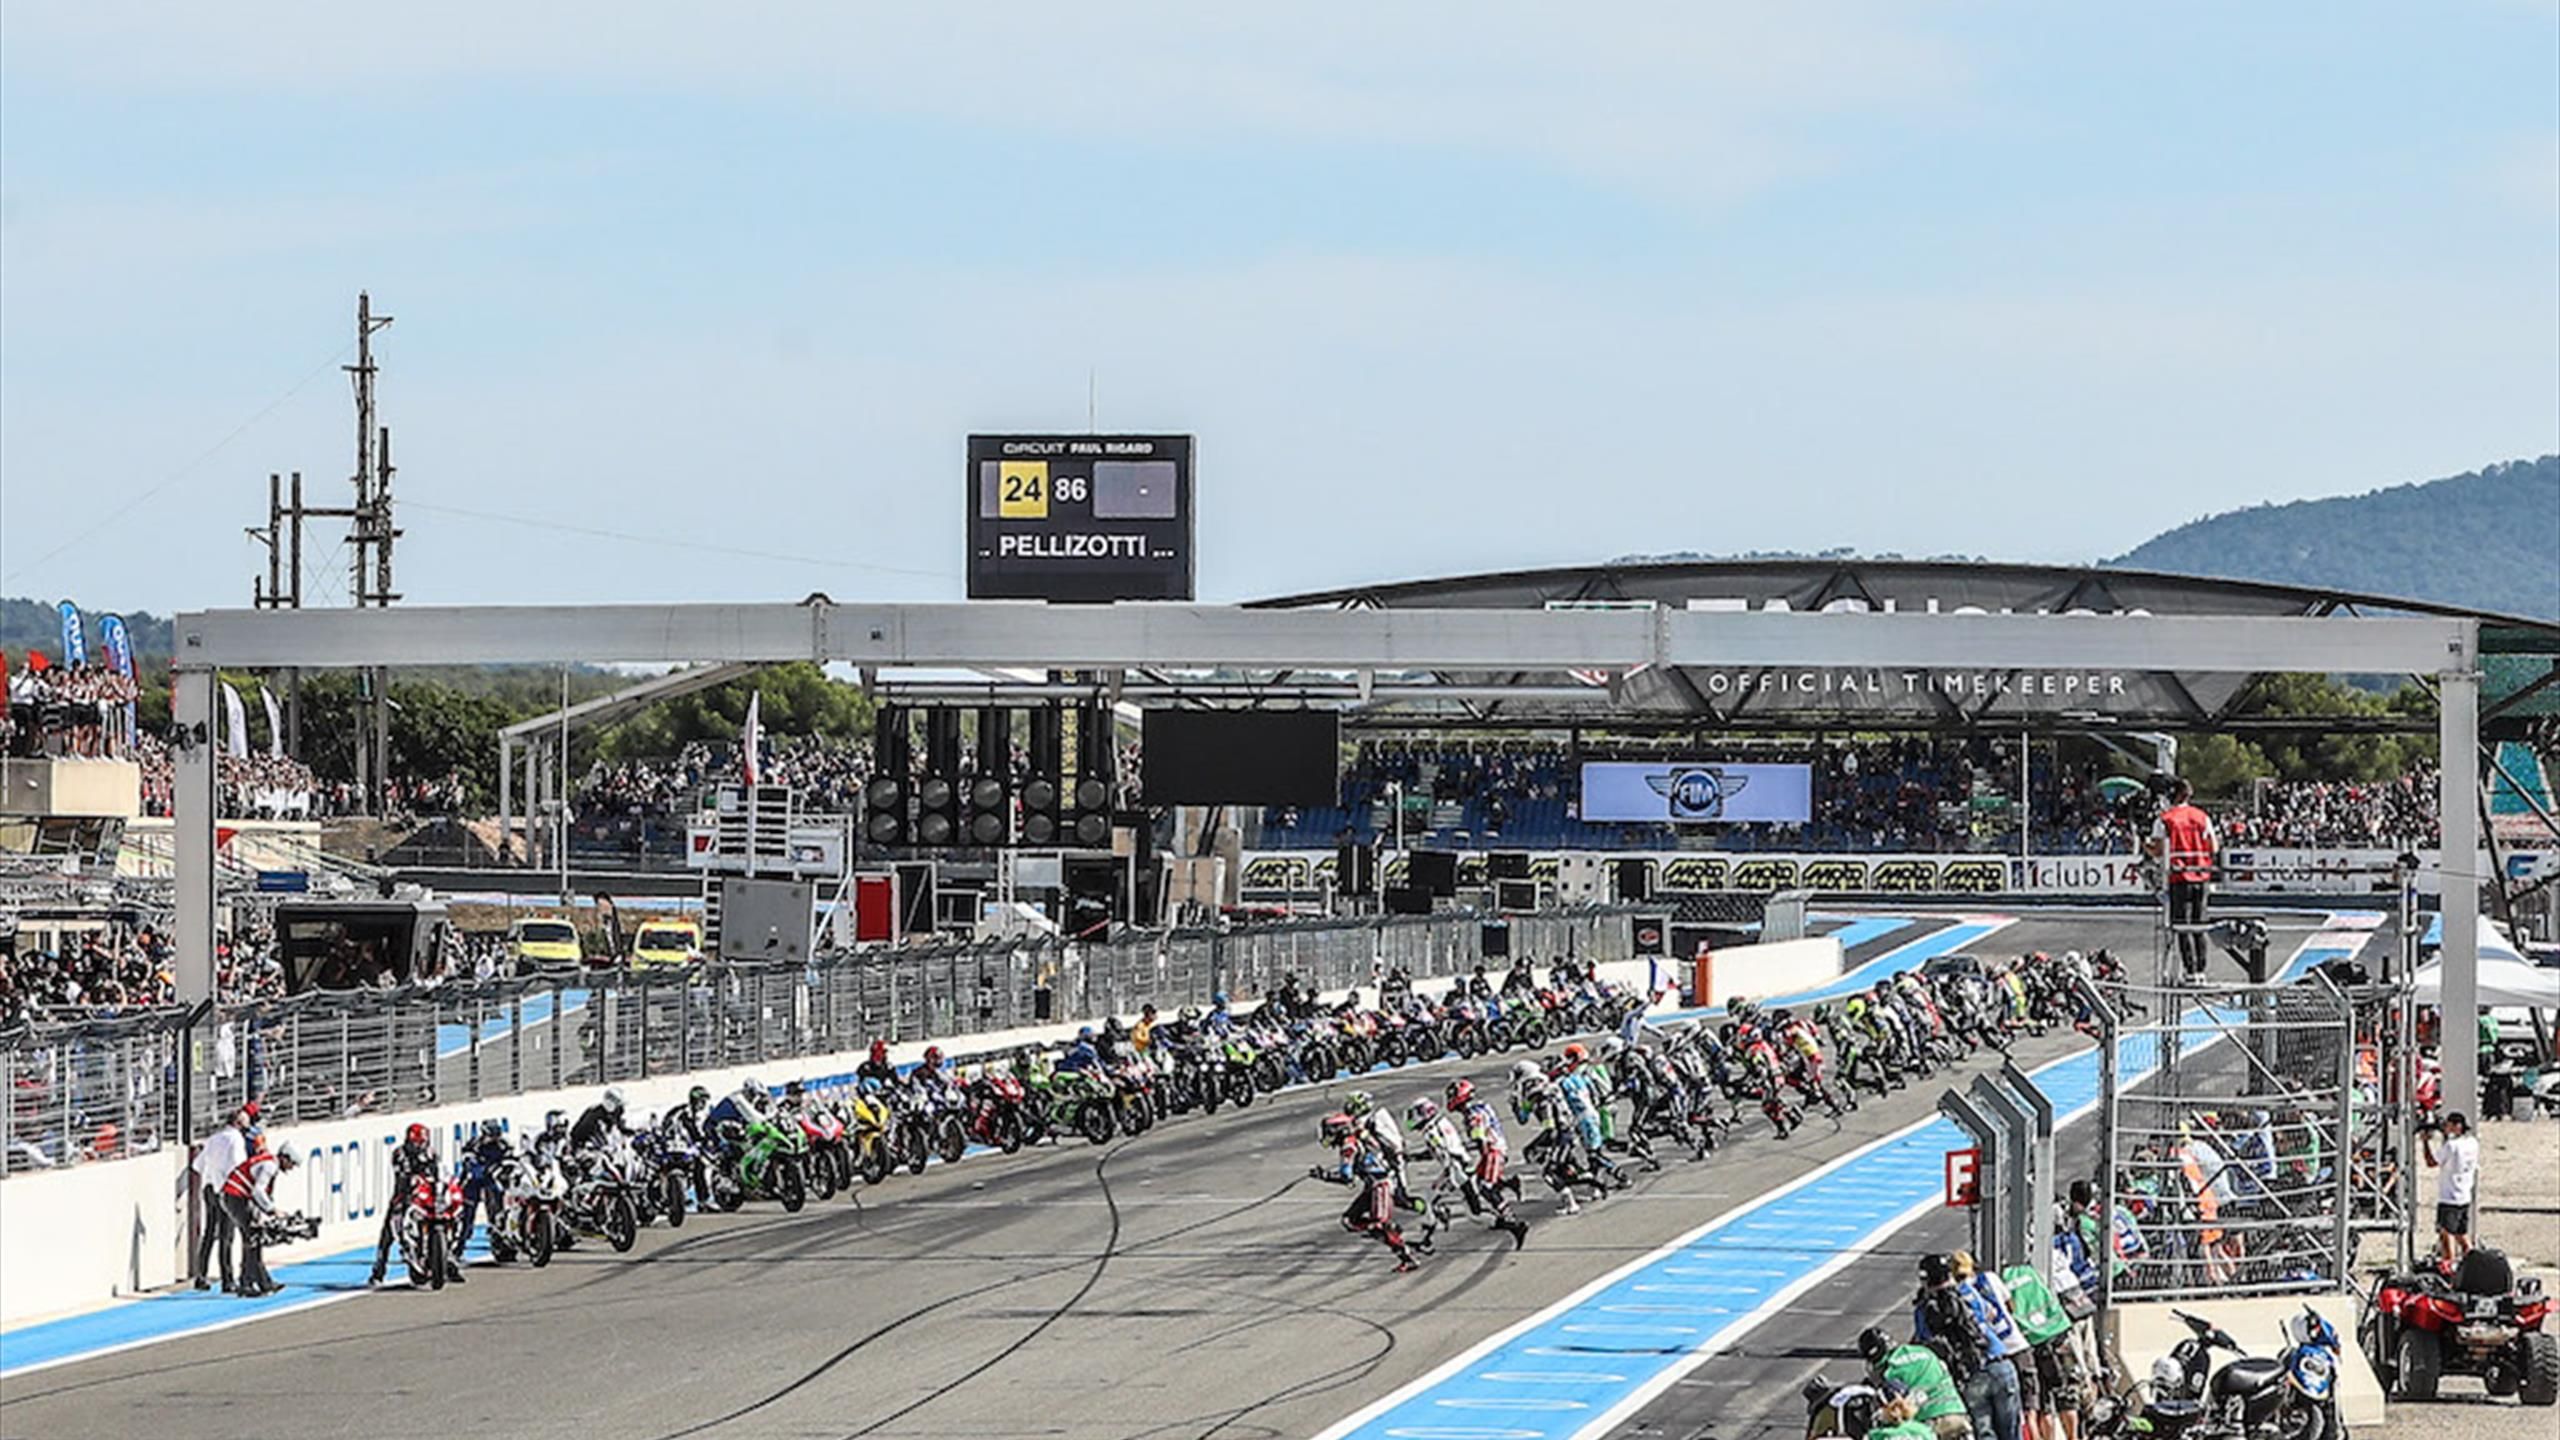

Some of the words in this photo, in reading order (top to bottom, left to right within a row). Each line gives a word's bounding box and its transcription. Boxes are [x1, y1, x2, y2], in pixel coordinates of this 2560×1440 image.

[1003, 442, 1066, 454] CIRCUIT
[1069, 442, 1103, 454] PAUL
[1105, 442, 1154, 454] RICARD
[1004, 477, 1042, 502] 24
[1055, 478, 1087, 501] 86
[1000, 535, 1146, 556] PELLIZOTTI
[1708, 672, 1880, 693] OFFICIAL
[1903, 673, 2127, 694] TIMEKEEPER
[1680, 782, 1713, 804] FIM
[2041, 861, 2139, 888] club14
[1951, 1155, 1973, 1202] F
